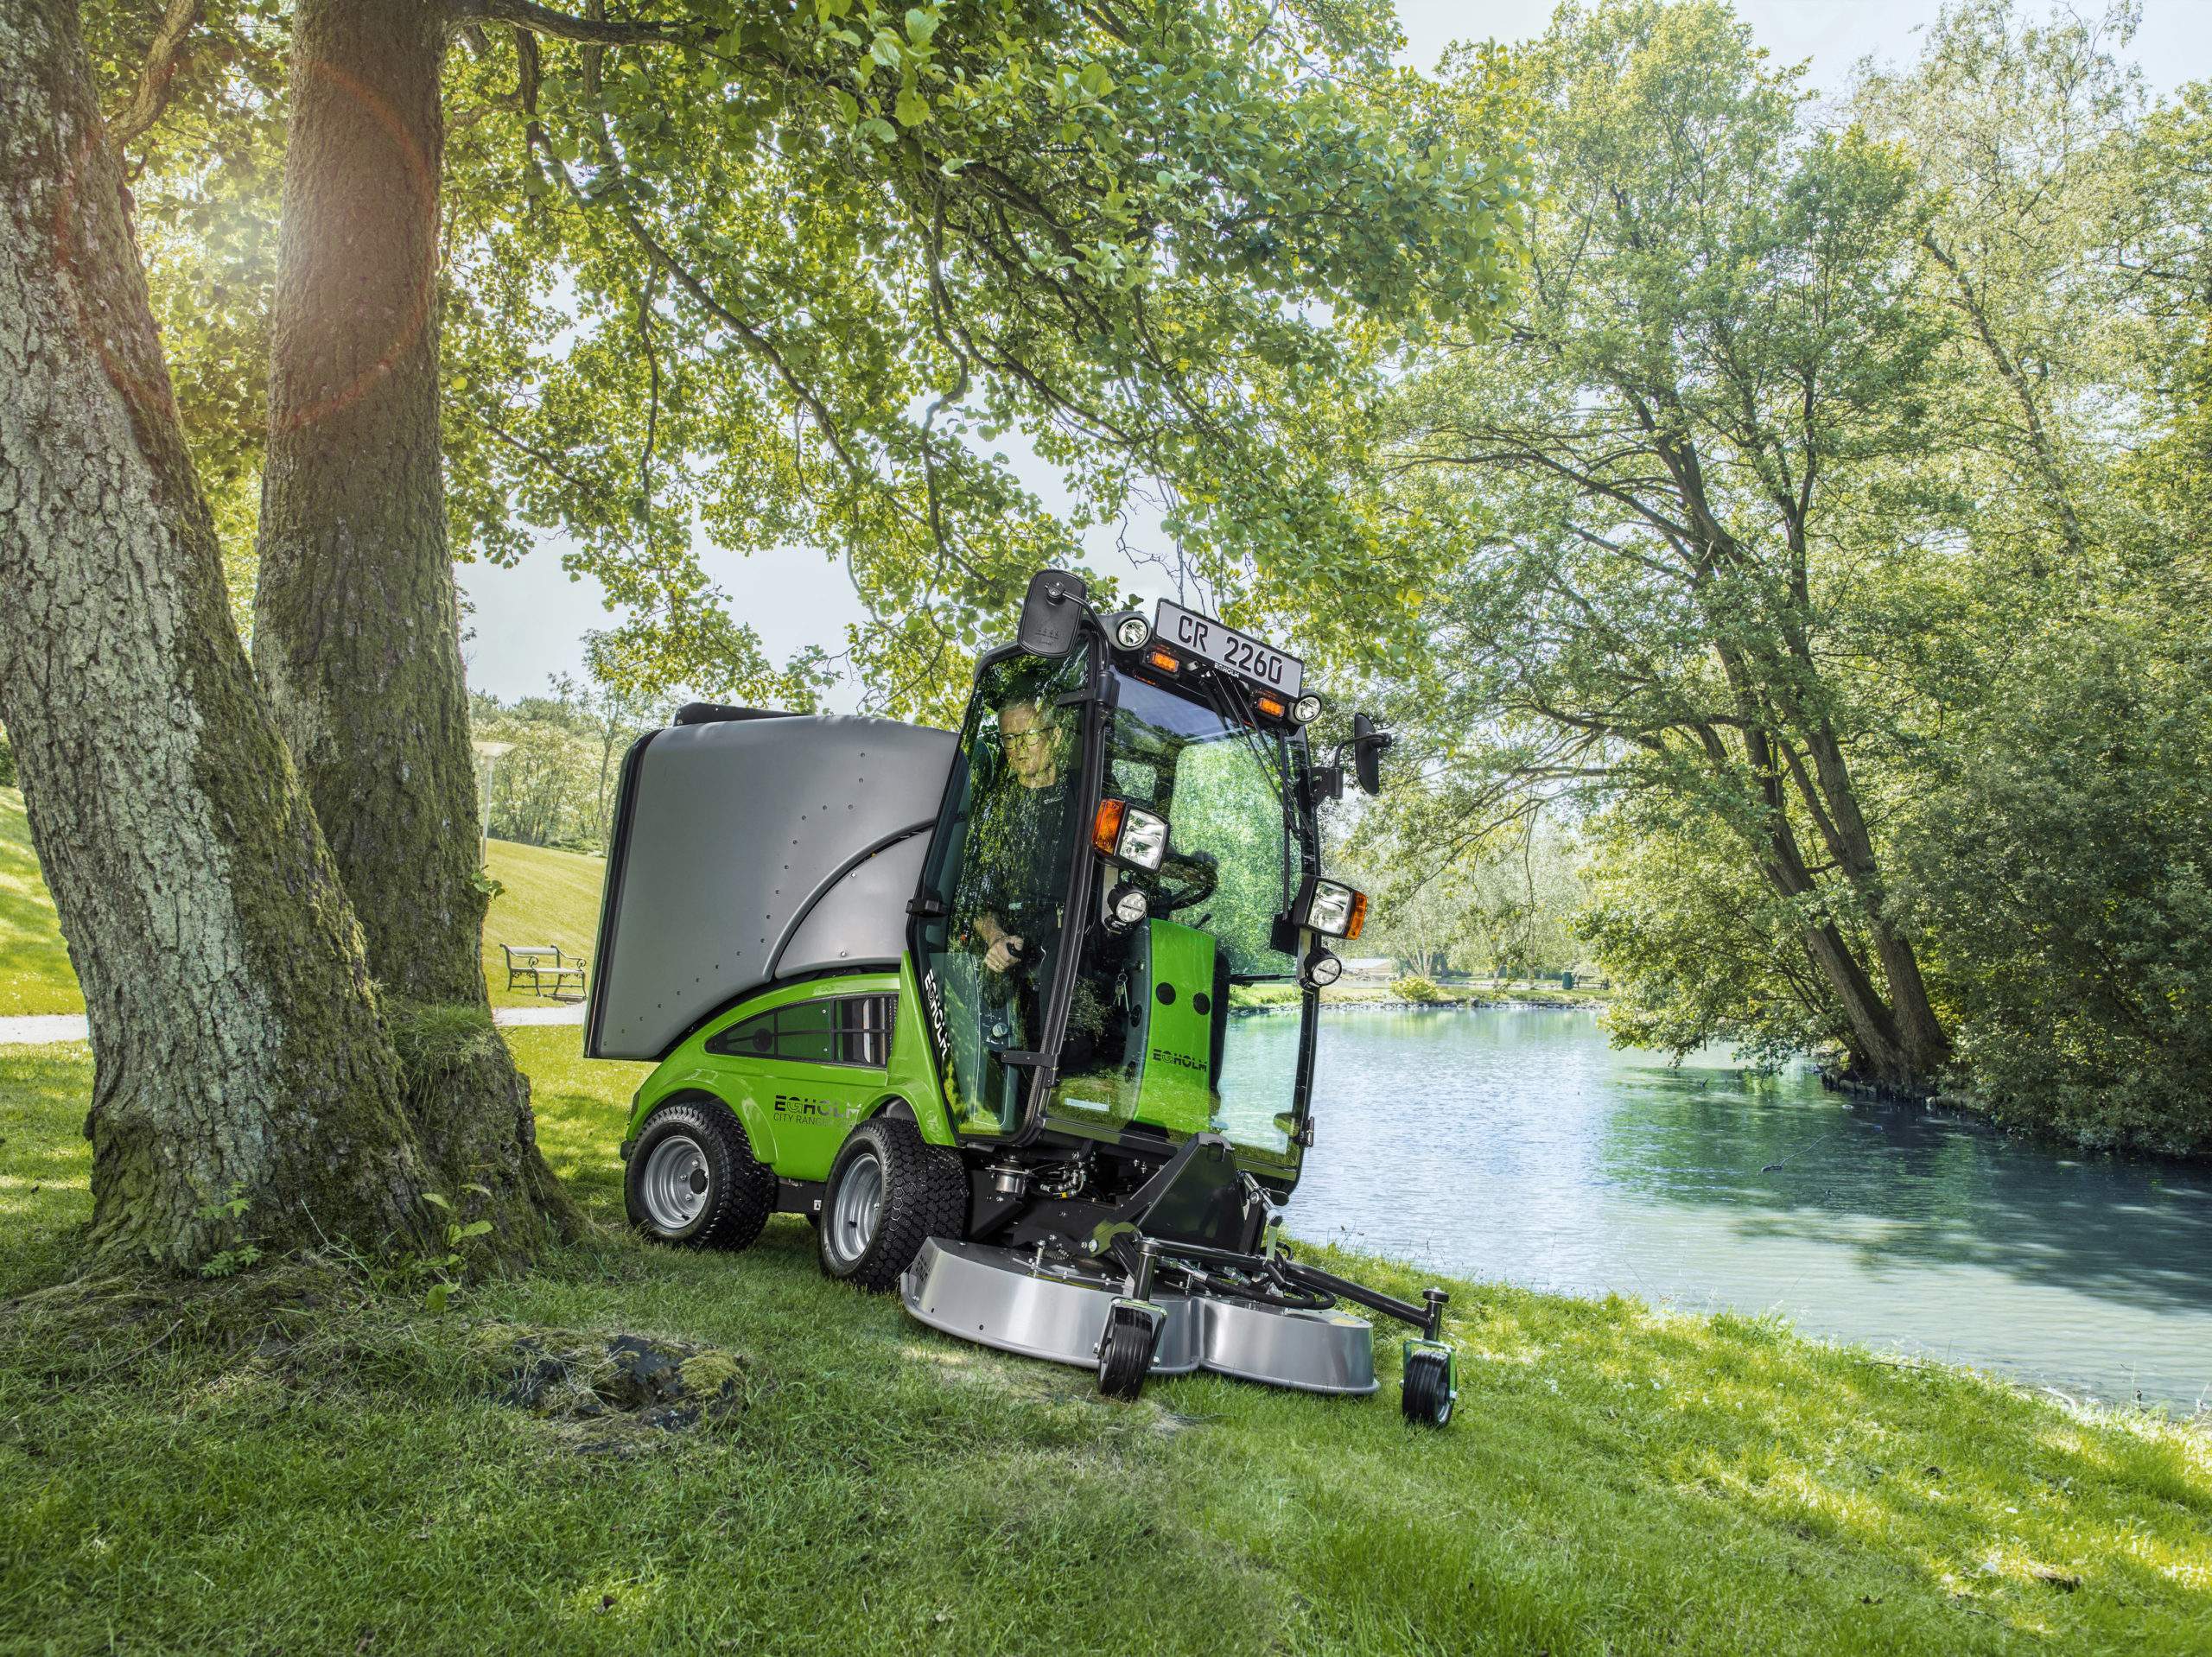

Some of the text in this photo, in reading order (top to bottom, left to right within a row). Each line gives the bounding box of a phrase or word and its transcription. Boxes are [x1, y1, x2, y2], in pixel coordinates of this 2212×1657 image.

[1178, 615, 1282, 685] CR 2260
[925, 968, 950, 1058] EGHOLM
[1153, 1048, 1207, 1072] EGHOLM
[774, 1095, 862, 1119] EGHOLM
[773, 1112, 794, 1123] CITY
[796, 1114, 835, 1127] RANGER
